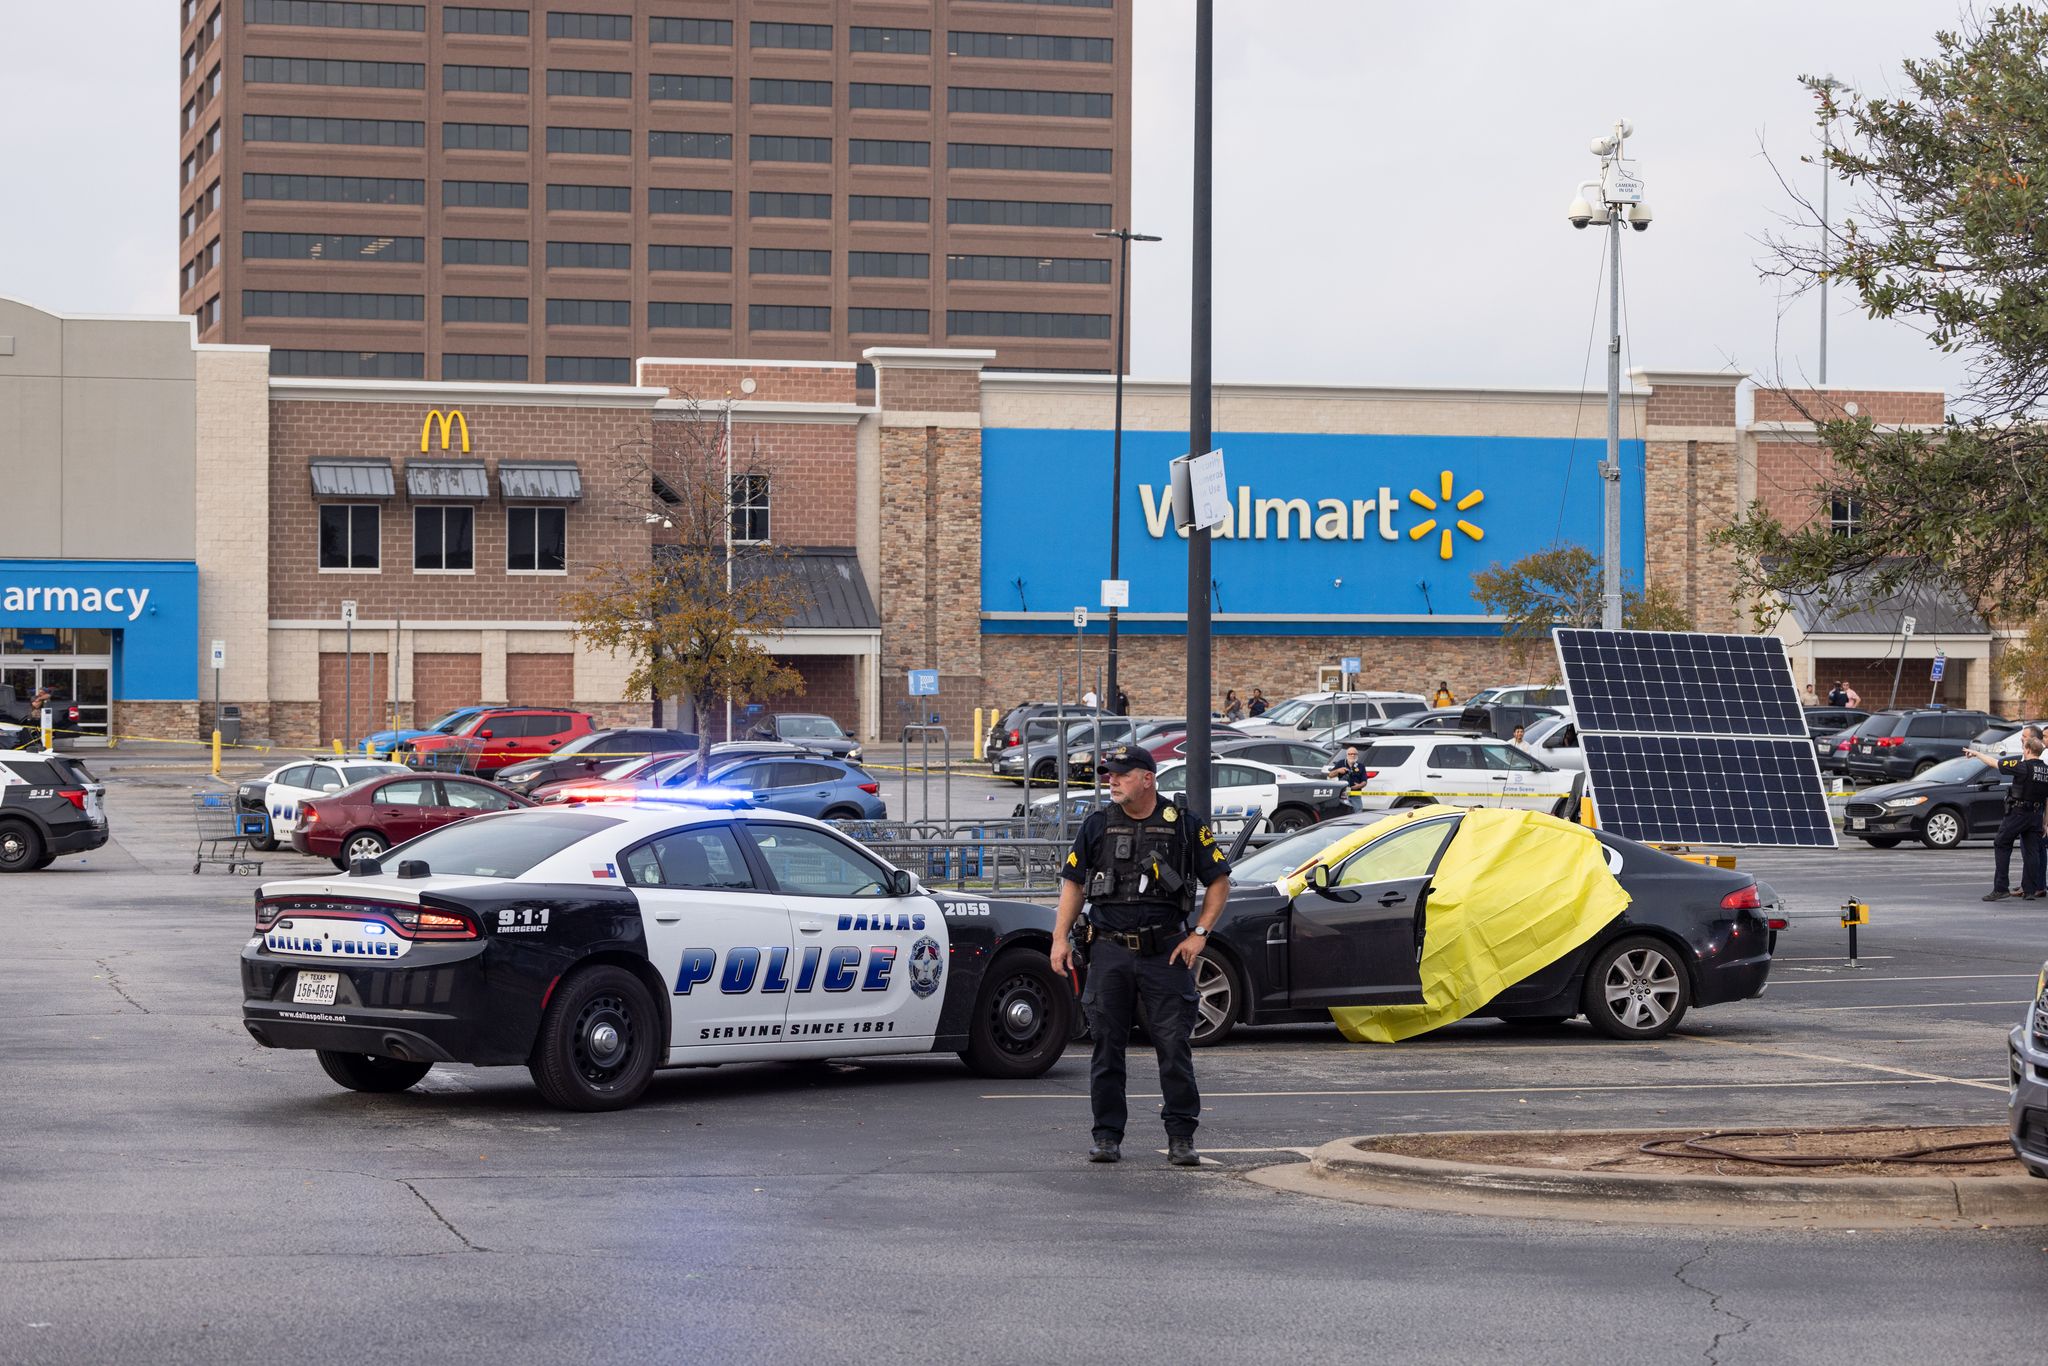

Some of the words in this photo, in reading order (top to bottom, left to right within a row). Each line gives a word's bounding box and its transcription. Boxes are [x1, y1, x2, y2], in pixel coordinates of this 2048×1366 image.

[346, 608, 352, 617] 4
[1077, 614, 1084, 623] 5
[943, 902, 991, 917] 2059
[837, 913, 926, 931] DALLAS
[497, 924, 548, 934] EMERGENCY
[268, 934, 323, 952] DALLAS
[332, 939, 399, 957] POLICE
[310, 973, 326, 981] TEXAS
[673, 946, 898, 996] POLICE
[279, 1011, 347, 1022] www.dallaspolice.net
[700, 1024, 782, 1040] SERVING
[790, 1022, 845, 1035] SINCE
[853, 1021, 895, 1033] 1881
